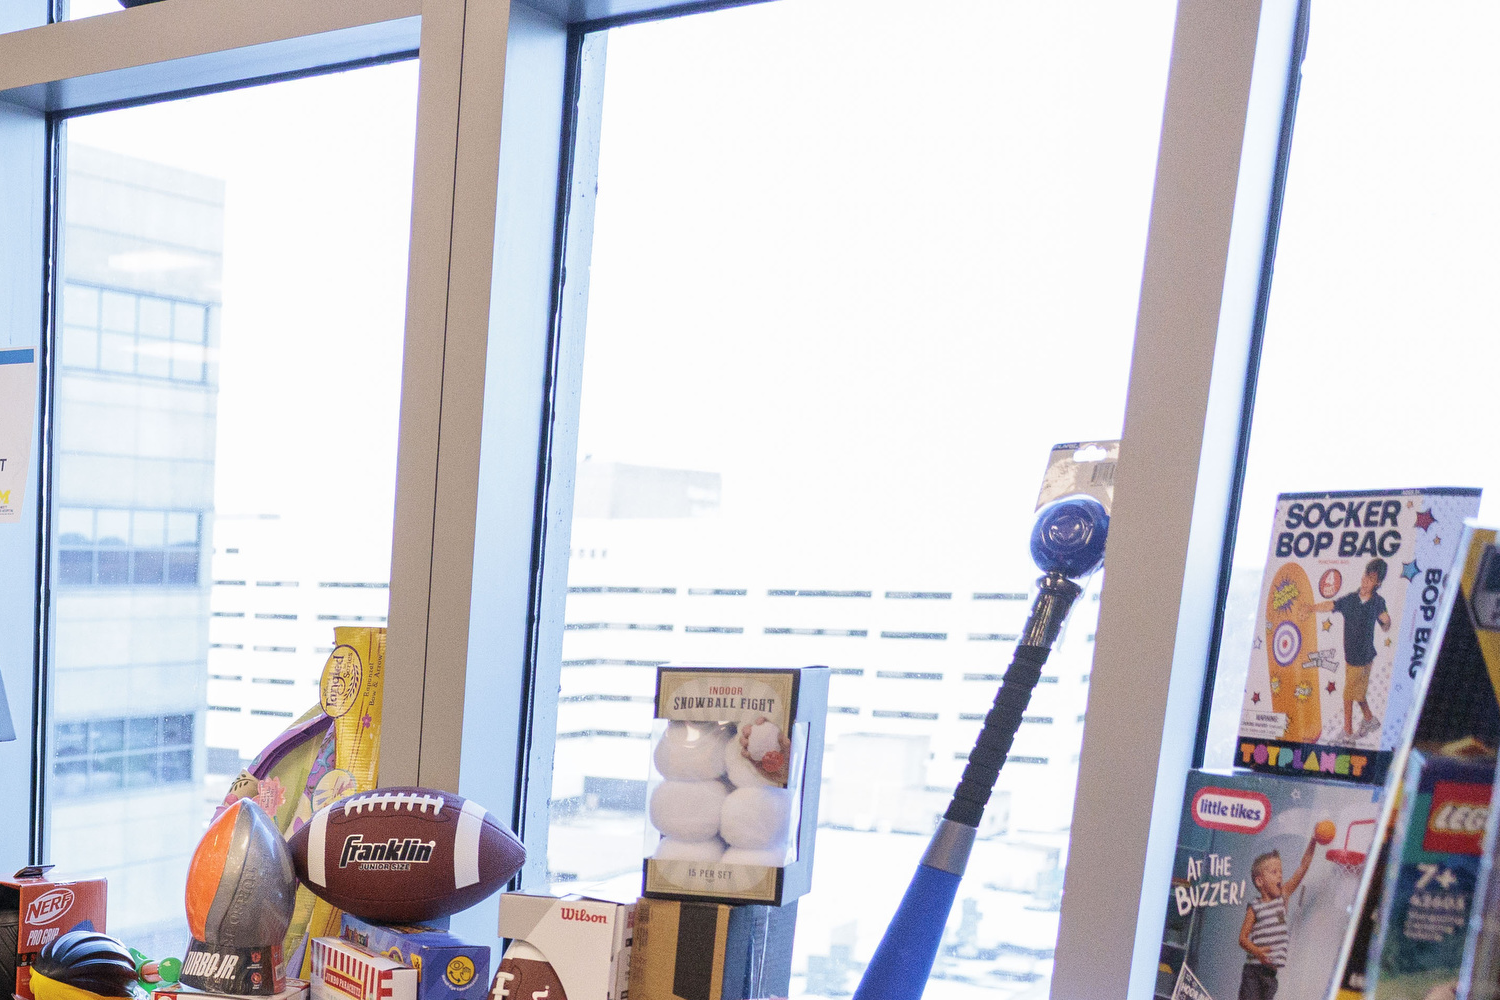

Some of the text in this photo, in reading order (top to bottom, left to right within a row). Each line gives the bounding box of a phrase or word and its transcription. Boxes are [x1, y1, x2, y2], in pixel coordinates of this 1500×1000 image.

[1285, 500, 1402, 529] SOCKER
[1275, 530, 1401, 558] BOP BAG
[708, 685, 743, 696] INDOOR
[673, 696, 776, 715] SNOWBALL FIGHT
[1200, 799, 1261, 821] little tikes
[339, 834, 433, 868] Franklin
[699, 869, 715, 880] PER
[717, 870, 732, 880] SET
[1187, 854, 1231, 881] AT THE
[26, 889, 74, 921] NERF
[1175, 880, 1246, 917] BUZZER!
[560, 907, 608, 925] Wilson
